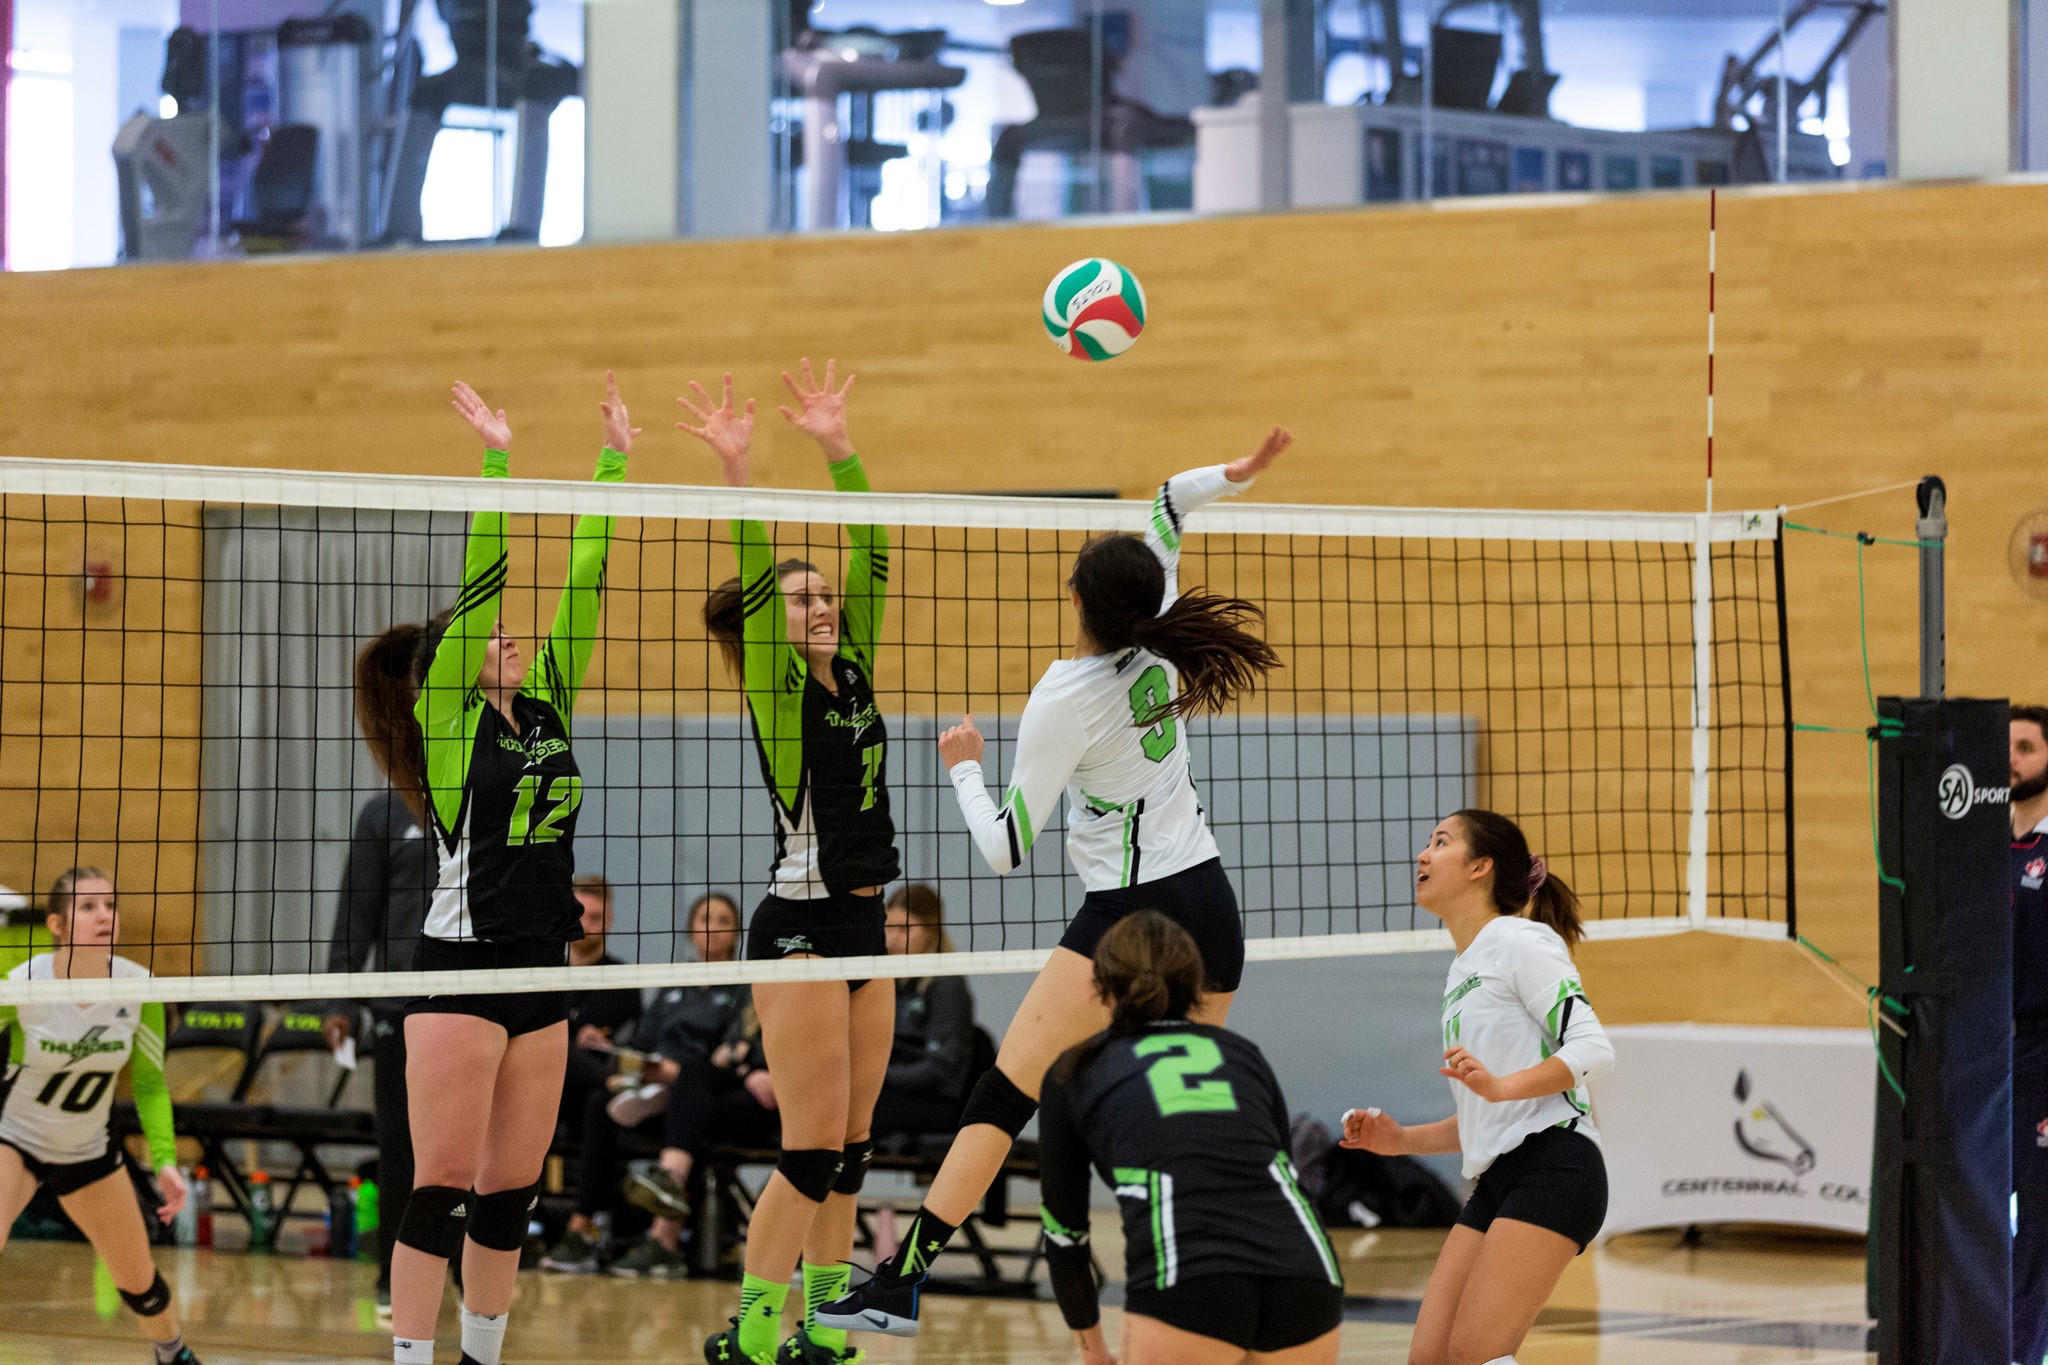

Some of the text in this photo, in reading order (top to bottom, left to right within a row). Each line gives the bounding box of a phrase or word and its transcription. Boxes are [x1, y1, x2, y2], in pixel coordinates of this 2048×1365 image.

[1128, 664, 1176, 763] 9
[506, 775, 583, 846] 12
[35, 1070, 116, 1113] 10
[1132, 1032, 1239, 1118] 2
[1661, 1176, 1807, 1198] CENTENNIAL
